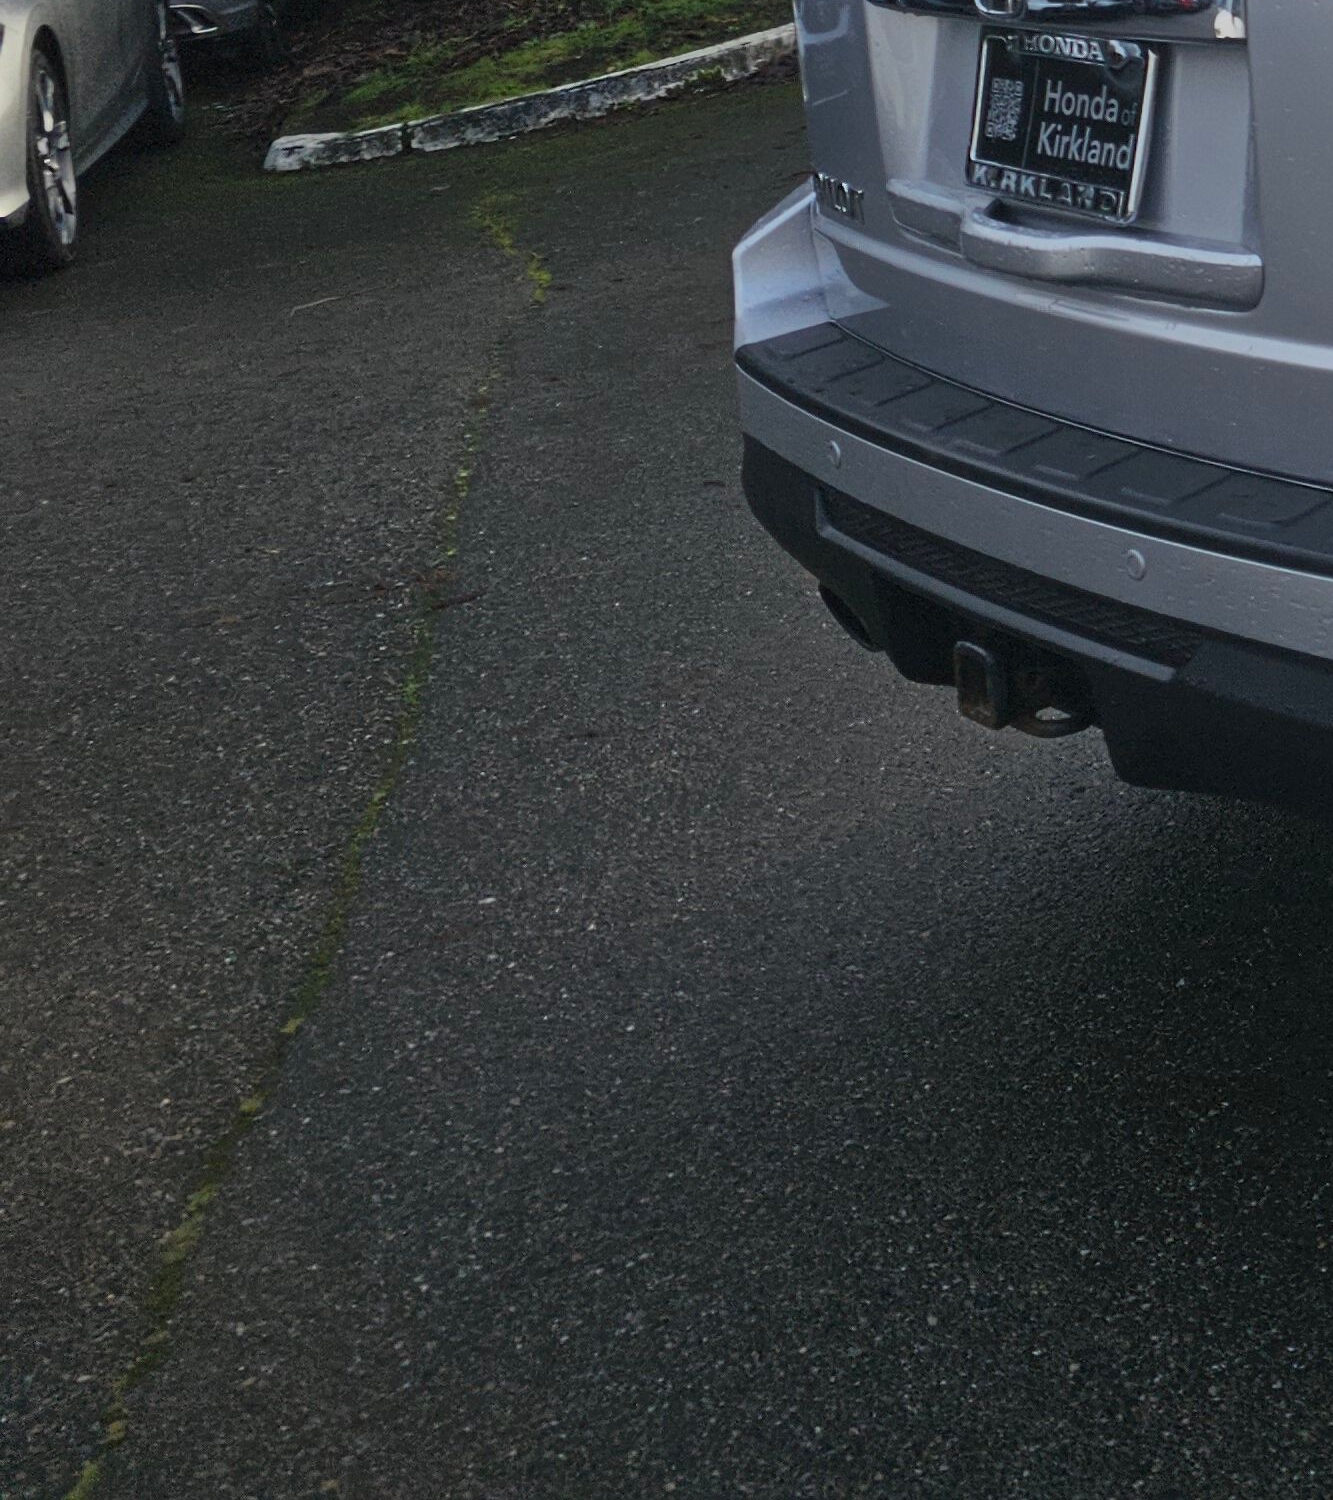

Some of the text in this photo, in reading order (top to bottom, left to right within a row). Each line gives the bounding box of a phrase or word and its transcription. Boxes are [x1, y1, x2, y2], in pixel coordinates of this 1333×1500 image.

[1024, 34, 1106, 62] HONDA
[1044, 79, 1137, 126] Honda of
[1035, 120, 1133, 170] Kirkland
